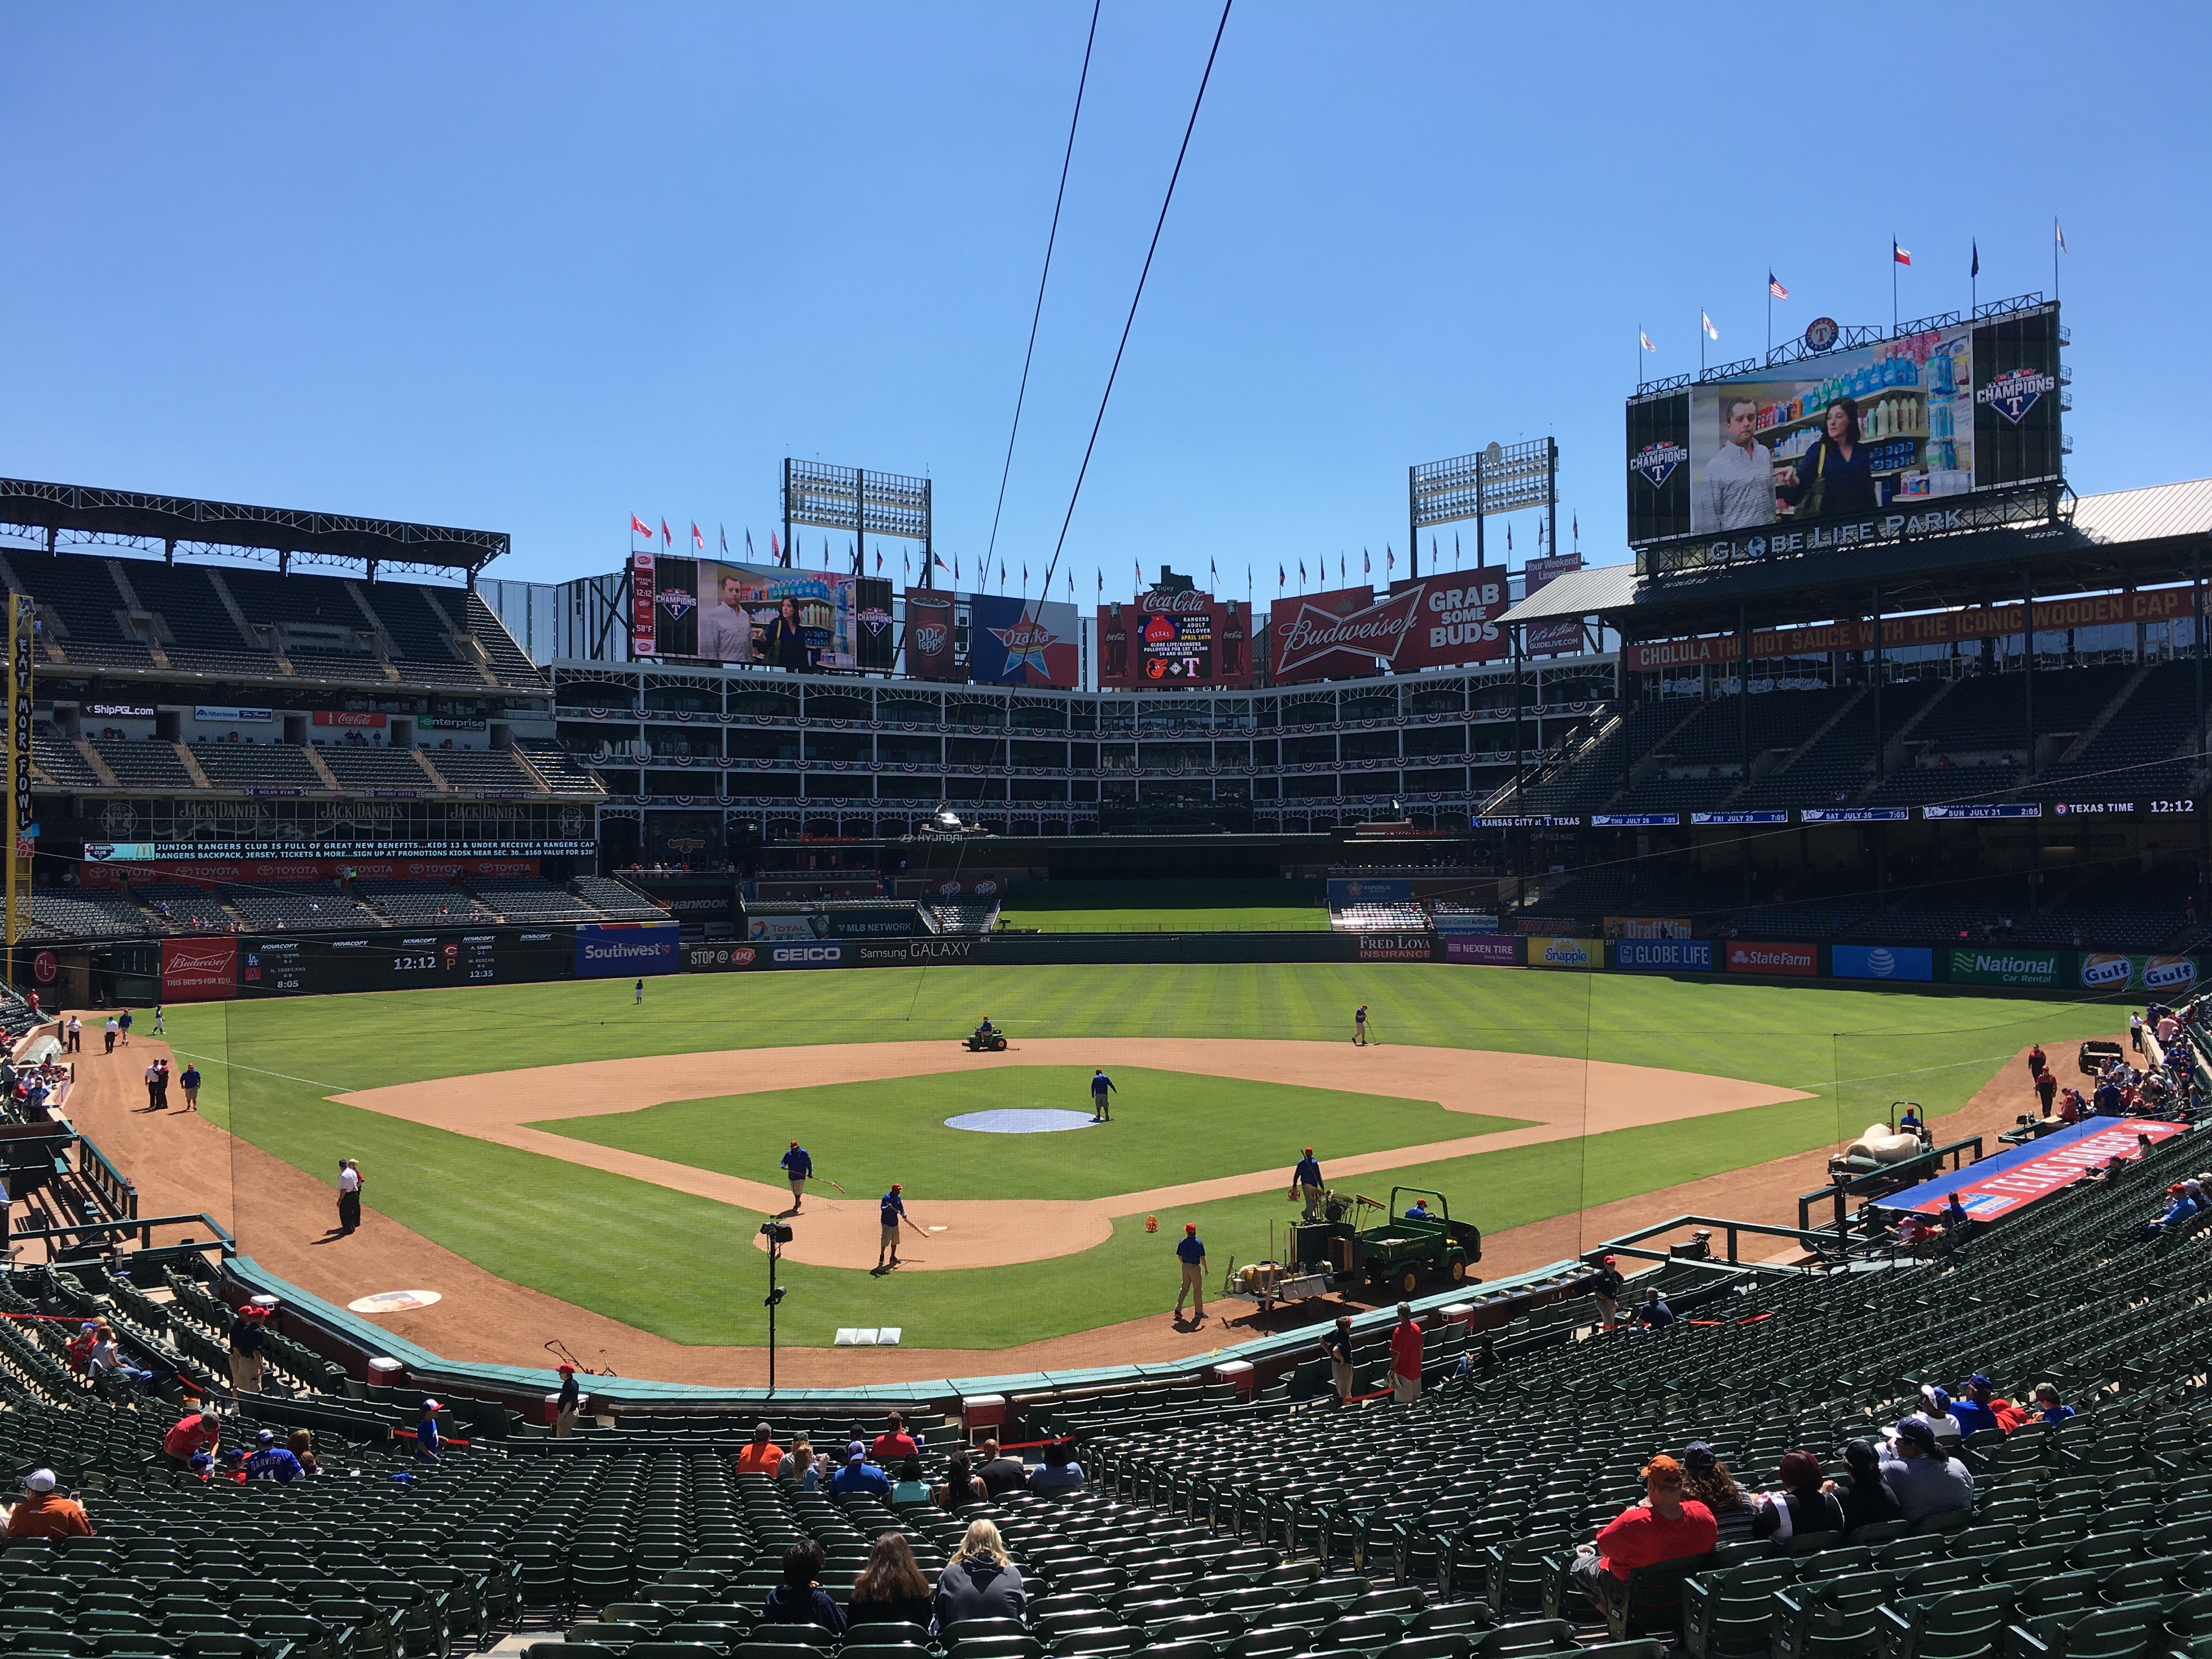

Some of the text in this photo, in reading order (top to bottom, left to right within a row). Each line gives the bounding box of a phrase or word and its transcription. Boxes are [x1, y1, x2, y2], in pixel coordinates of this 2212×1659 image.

[1977, 376, 2055, 404] CHAMPIONS
[1630, 448, 1687, 471] CHAMPIONS
[1814, 521, 1874, 546] LIFE
[1885, 509, 1963, 537] PARK
[1526, 555, 1578, 572] Your Weekend
[636, 589, 652, 597] 12:12
[1429, 583, 1500, 613] GRAB
[656, 595, 697, 606] CHAMPIONS
[1142, 590, 1206, 612] Coca-Cola
[857, 613, 893, 624] CHAMPIONS
[1441, 606, 1487, 625] SOME
[1150, 630, 1170, 639] TEXAS
[1278, 612, 1419, 652] Budweiser
[1430, 622, 1500, 648] BUDS
[1528, 627, 1547, 644] Let's
[1640, 641, 1711, 665] CHOLULA
[1717, 637, 1741, 657] TH
[1753, 633, 1785, 654] HOT
[1792, 625, 1850, 650] SAUCE
[1858, 621, 1904, 644] WTH
[1911, 618, 1948, 638] THE
[1956, 608, 2023, 634] ICONIC
[2032, 597, 2124, 627] WOODEN
[2132, 592, 2178, 617] CAP
[916, 627, 946, 653] Dr Pepper
[1003, 629, 1049, 647] Ozarka
[1529, 637, 1578, 650] GUIDELIVE.COM
[18, 639, 29, 689] EAT
[94, 704, 154, 715] ShipPGL.com
[420, 718, 485, 728] enterprise
[18, 759, 29, 827] FOWL
[179, 800, 269, 818] JACK DANIEL'S
[321, 802, 404, 819] JACK DANIEL'S
[449, 804, 526, 819] JACK DANIEL'S
[2069, 803, 2134, 813] TEXAS TIME
[2151, 800, 2194, 812] 12:12
[1481, 817, 1581, 827] KANSAS CITY TEXAS
[109, 868, 156, 877] TOYOTA
[194, 867, 240, 876] TOYOTA
[275, 866, 318, 874] TOYOTA
[353, 865, 393, 873] TOYOTA
[425, 865, 464, 873] TOYOTA
[771, 924, 806, 933] TOTAL
[847, 923, 912, 932] MLB NETWORK
[1359, 935, 1431, 949] FRED LOYA
[585, 943, 661, 959] Southwest
[773, 947, 841, 962] GEICO
[860, 942, 971, 960] Samsung GALAXY
[1360, 950, 1431, 958] INSURANCE
[1463, 944, 1513, 955] NEXEN TIRE
[1545, 947, 1587, 965] Snapple
[1635, 945, 1709, 965] GLOBE LIFE
[170, 957, 227, 968] Budweiser
[394, 956, 437, 970] 12:12
[691, 951, 753, 964] STOP DQ
[1975, 955, 2055, 974] National
[470, 970, 493, 978] 12:35
[2021, 974, 2051, 983] Rental
[2085, 962, 2129, 982] Gulf
[2145, 964, 2191, 985] Gulf
[1981, 1131, 2155, 1193] TEXAS RANGERS
[251, 1457, 281, 1471] DARVISH
[258, 1469, 274, 1480] 11
